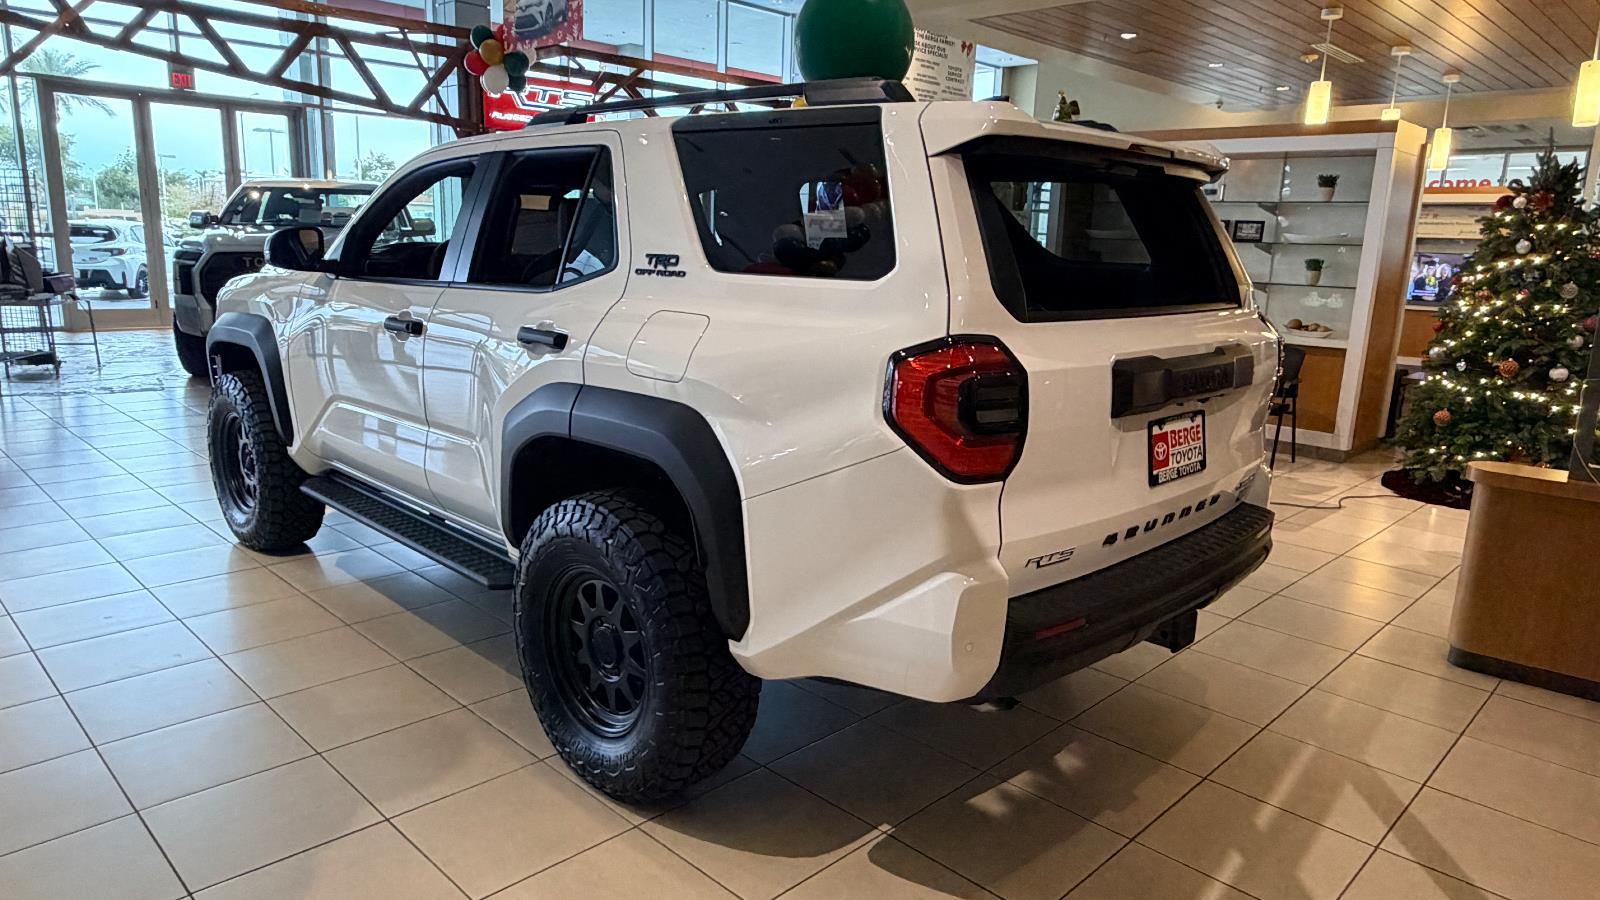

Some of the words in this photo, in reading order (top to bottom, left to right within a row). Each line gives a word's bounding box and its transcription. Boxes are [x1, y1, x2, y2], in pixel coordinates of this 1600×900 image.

[171, 72, 193, 89] EXIT
[1427, 178, 1492, 188] come
[645, 253, 680, 270] TRD
[635, 268, 656, 276] OFF
[656, 269, 687, 278] ROAD
[1170, 424, 1202, 449] BERGE
[1170, 444, 1203, 466] TOYOTA
[1158, 467, 1179, 484] BERGE
[1179, 461, 1202, 477] TOYOTA
